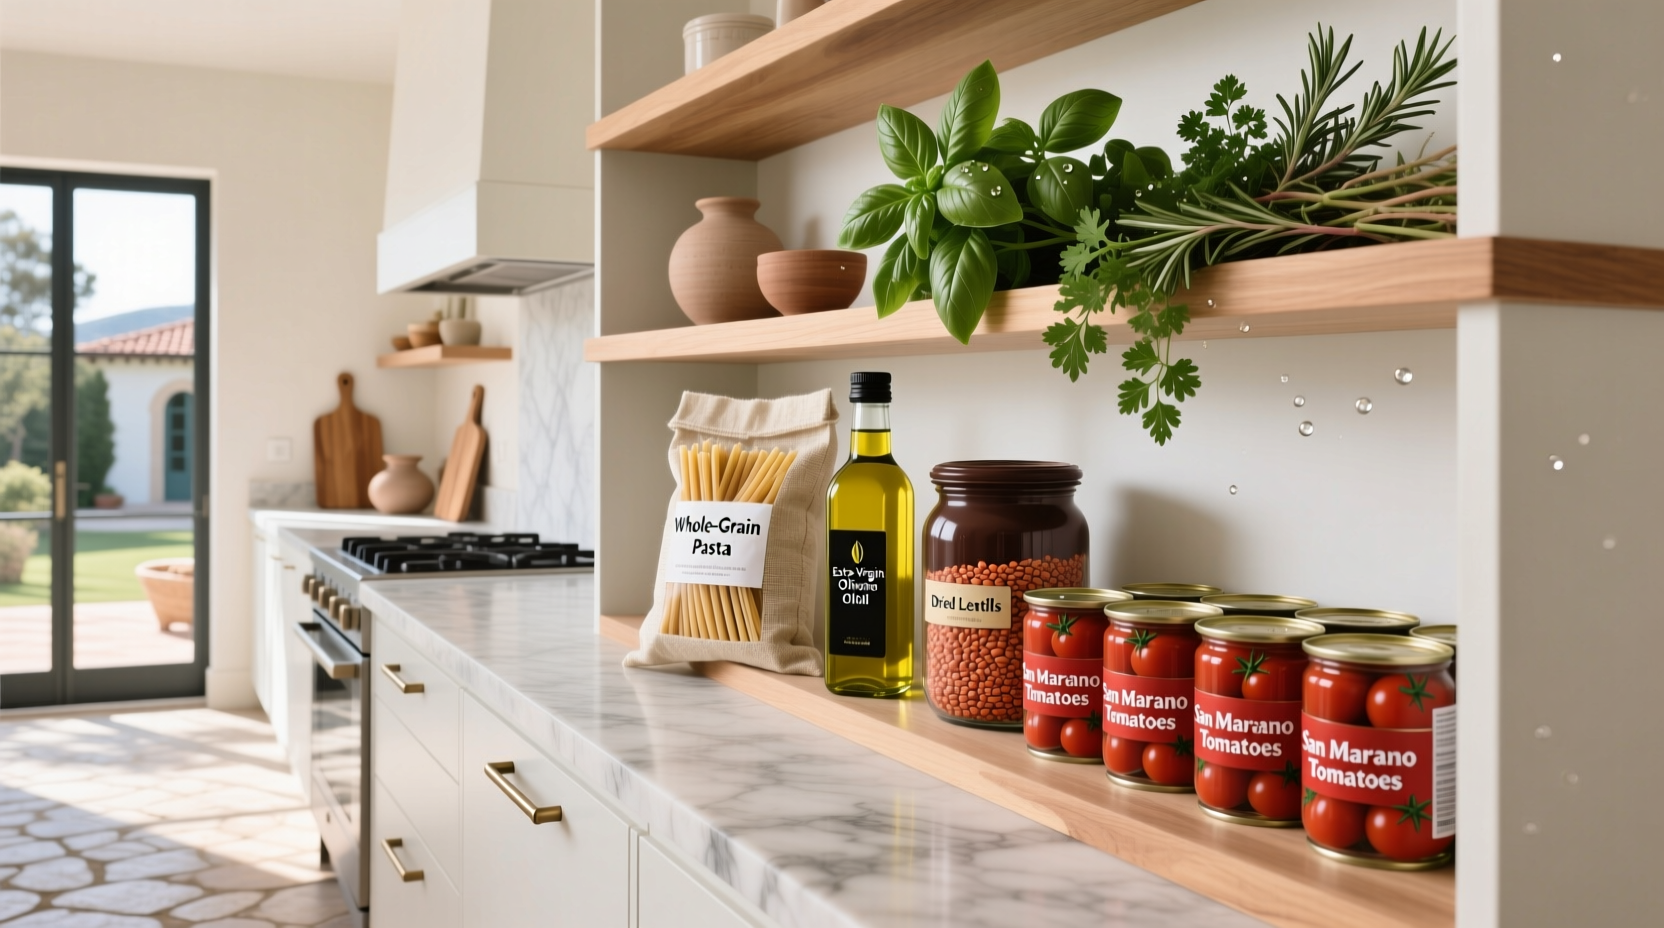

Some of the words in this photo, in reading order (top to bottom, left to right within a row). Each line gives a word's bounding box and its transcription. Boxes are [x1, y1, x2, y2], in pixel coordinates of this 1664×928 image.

[675, 515, 761, 535] Whole-Grain
[692, 538, 731, 556] Pasta
[1121, 689, 1188, 710] Marano
[1194, 704, 1213, 728] San
[1199, 728, 1282, 757] Tomatoes
[1302, 729, 1325, 757] San
[1329, 739, 1417, 767] Marano
[1308, 757, 1403, 791] Tomatoes
